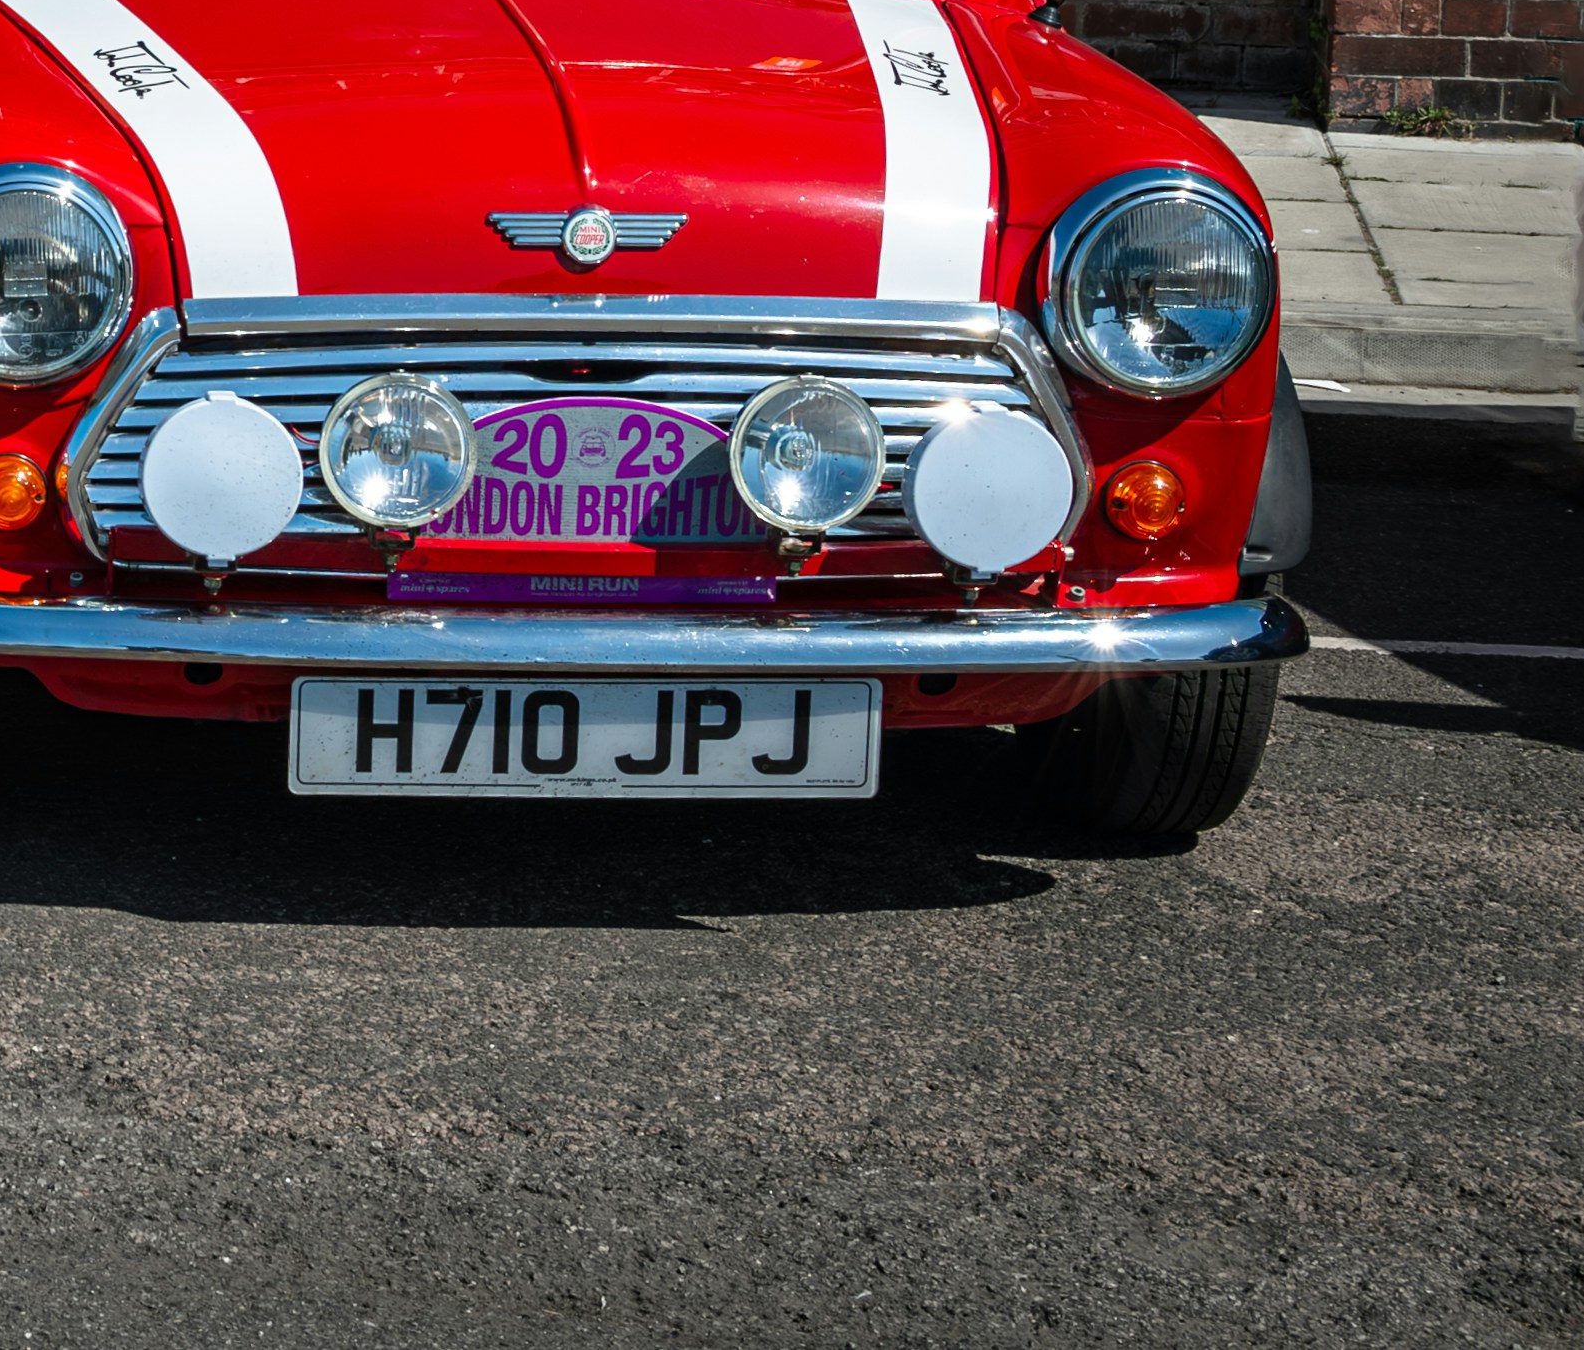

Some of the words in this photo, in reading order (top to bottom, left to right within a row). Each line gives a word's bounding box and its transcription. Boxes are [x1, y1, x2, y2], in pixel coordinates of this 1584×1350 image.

[574, 234, 605, 246] COOPER
[579, 225, 601, 234] MINI
[490, 413, 568, 479] 20
[615, 413, 686, 480] 23
[421, 475, 563, 537] NDON
[530, 576, 584, 592] MINI
[587, 576, 640, 592] RUN
[355, 687, 580, 776] H710
[614, 687, 812, 776] JPJ
